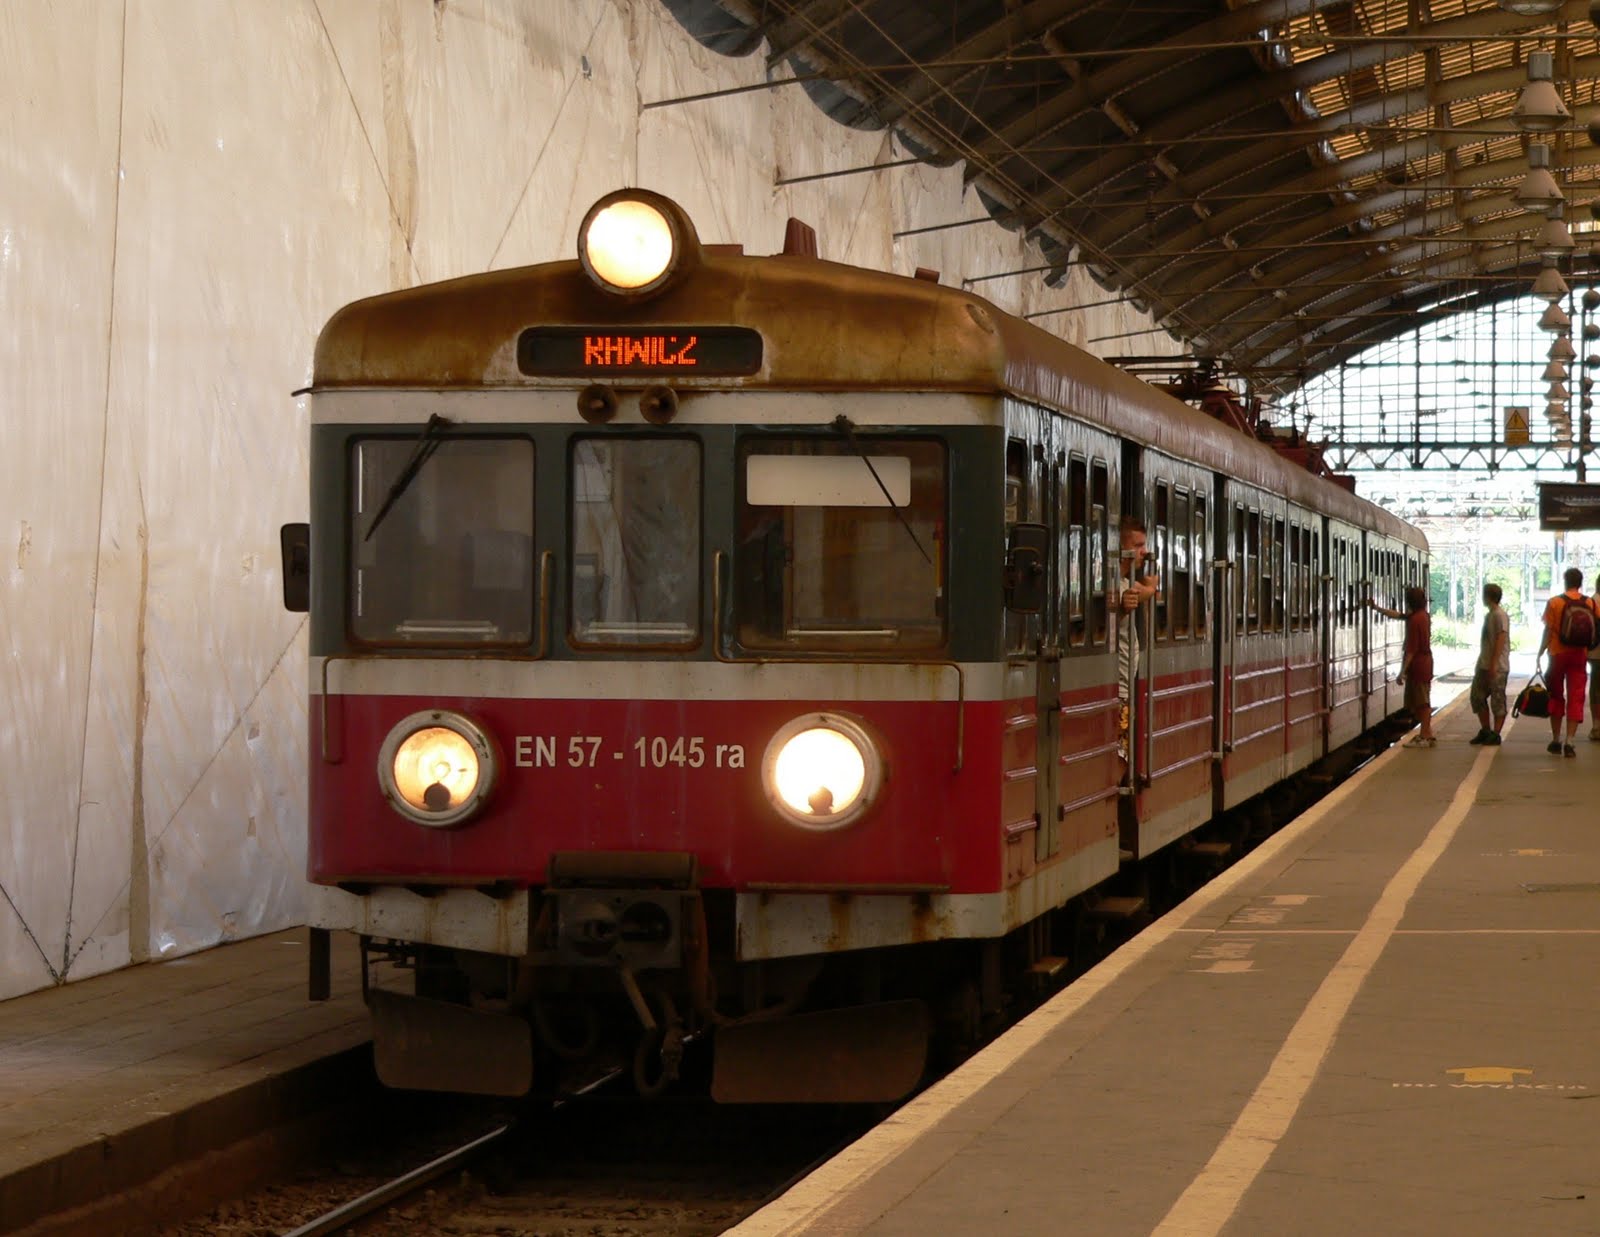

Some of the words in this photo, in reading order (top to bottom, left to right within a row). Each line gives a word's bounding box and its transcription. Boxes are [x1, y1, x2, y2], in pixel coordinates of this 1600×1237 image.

[515, 736, 556, 767] EN
[567, 736, 602, 767] 57
[634, 736, 705, 768] 1045
[715, 744, 745, 768] ra
